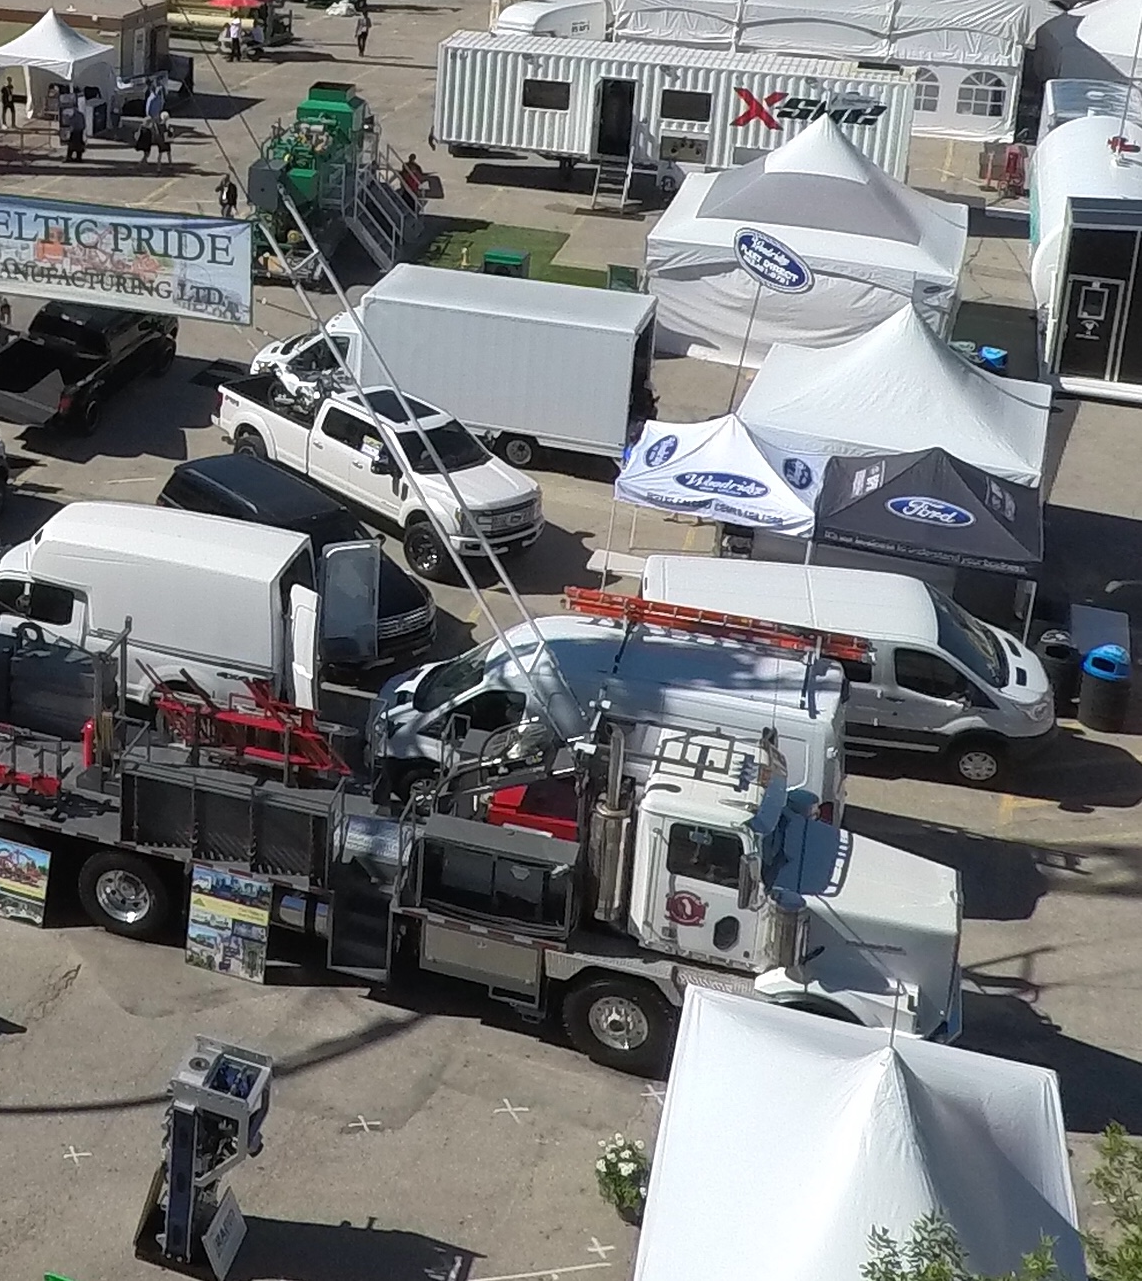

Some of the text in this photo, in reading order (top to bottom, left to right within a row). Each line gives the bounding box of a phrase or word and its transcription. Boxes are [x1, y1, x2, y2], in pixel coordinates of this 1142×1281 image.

[110, 222, 235, 266] PRIDE
[763, 259, 799, 283] DIRECT
[902, 500, 956, 523] Ford
